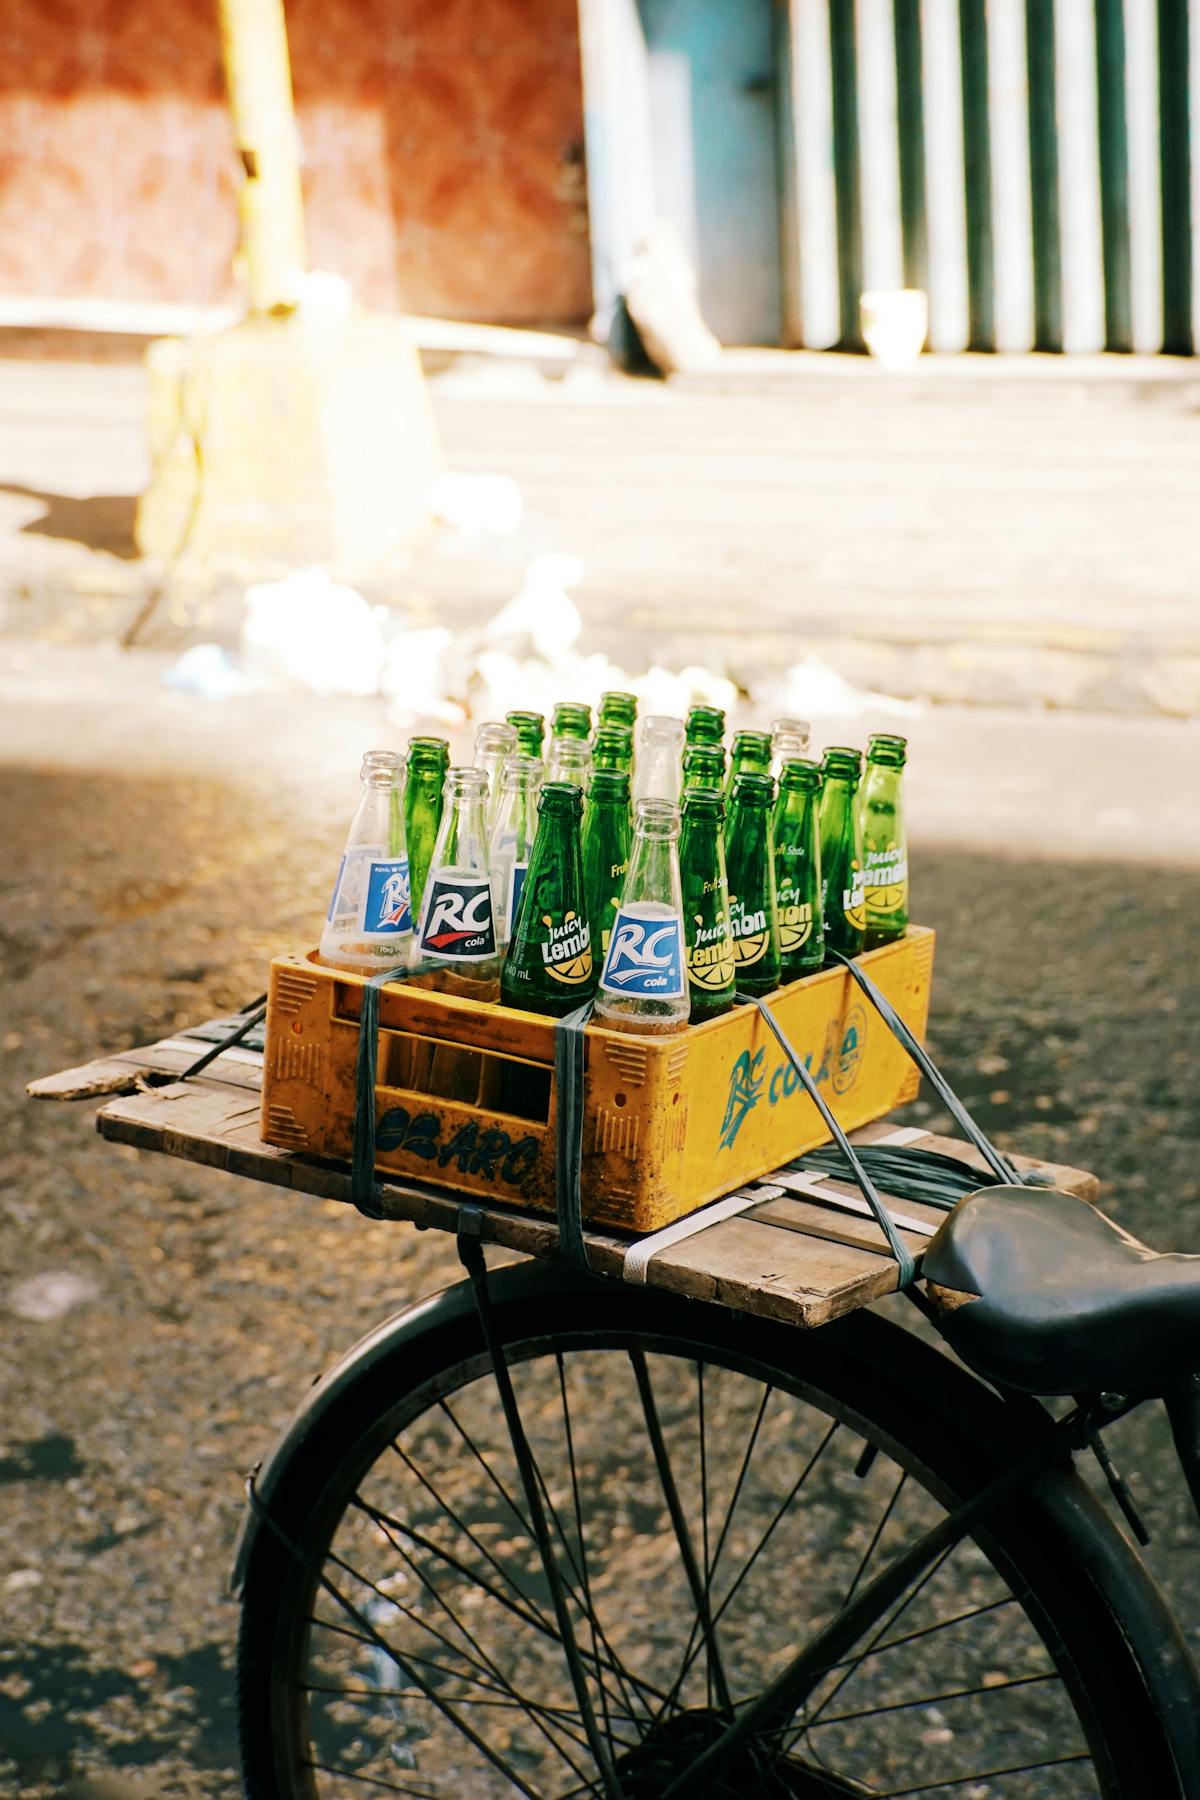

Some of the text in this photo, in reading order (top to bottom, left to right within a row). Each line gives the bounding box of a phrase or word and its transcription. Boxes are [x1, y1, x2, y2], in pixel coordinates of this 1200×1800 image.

[425, 891, 490, 940] RC
[465, 936, 485, 948] cola
[608, 924, 677, 973] RC
[686, 937, 734, 967] Lemo
[644, 976, 668, 988] cola
